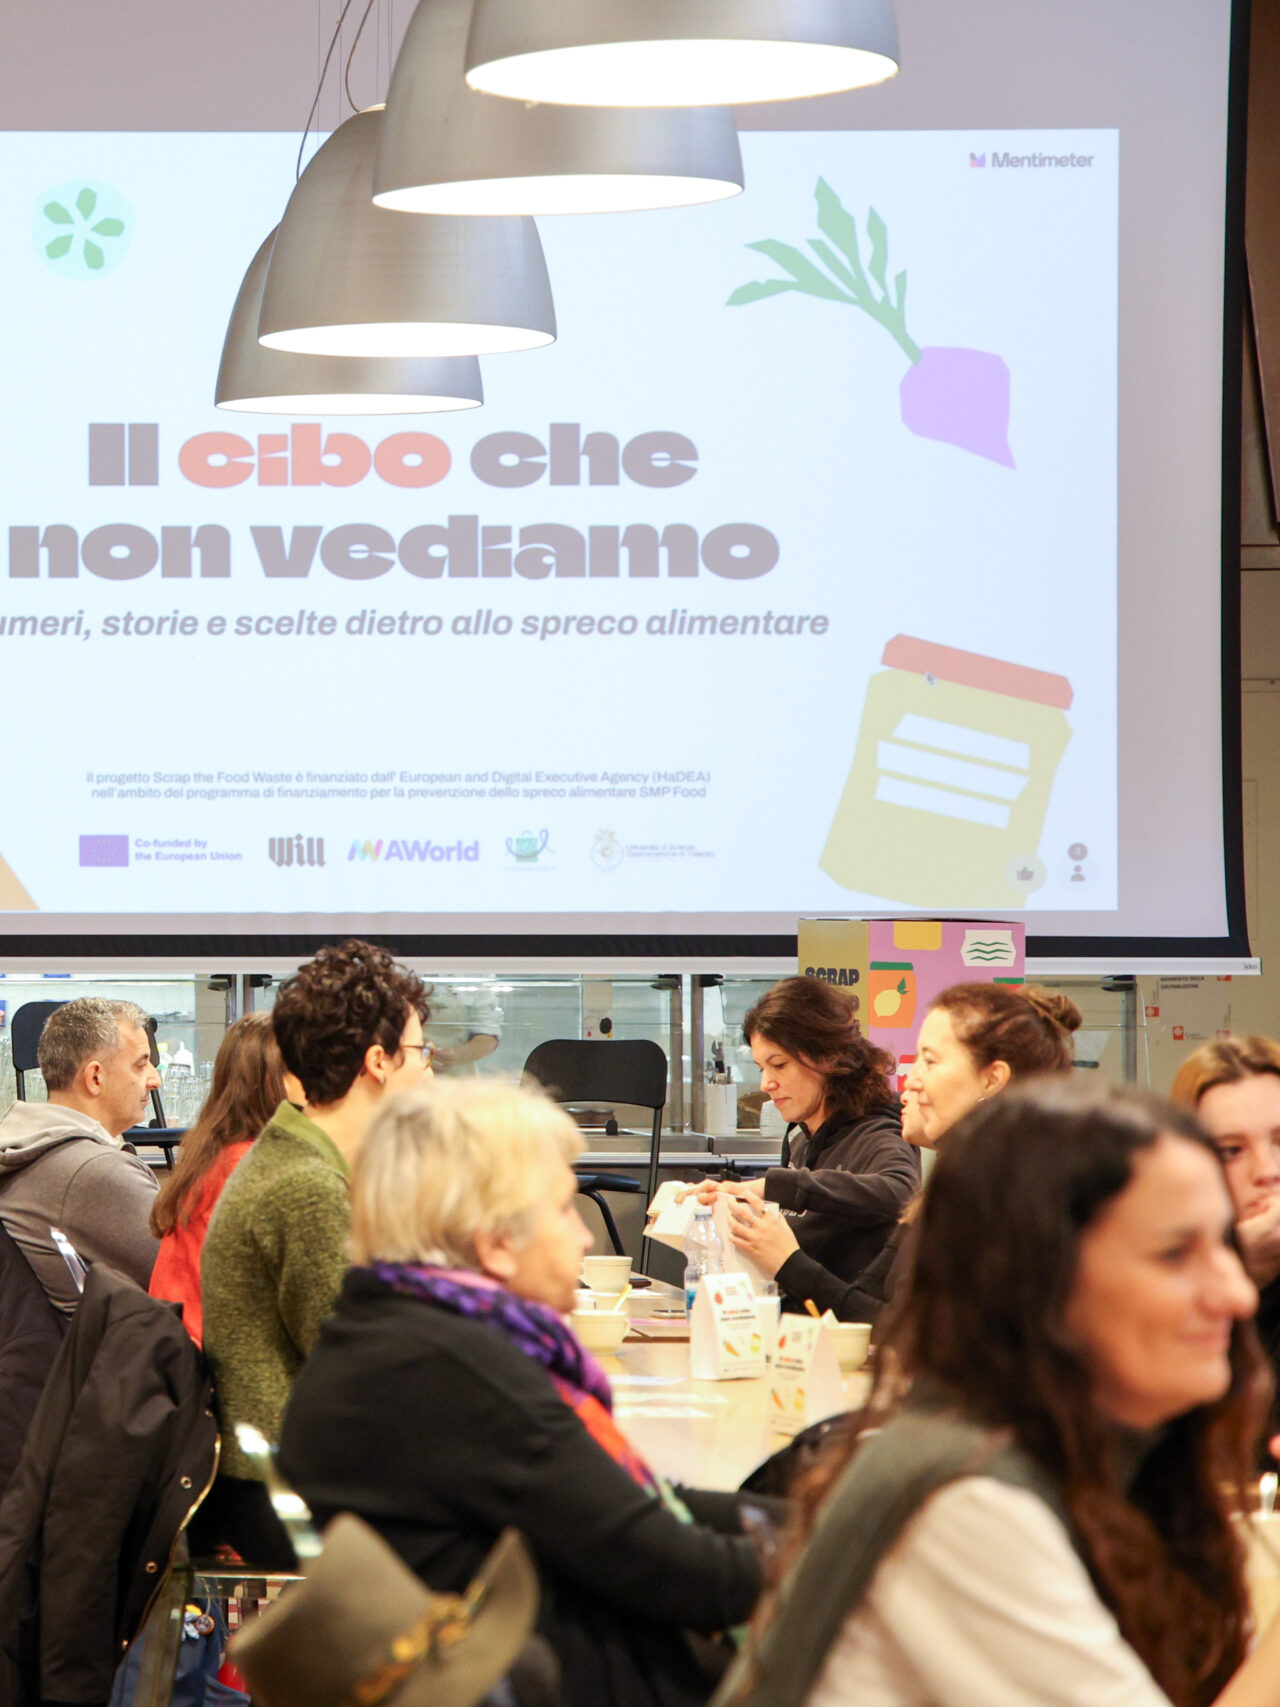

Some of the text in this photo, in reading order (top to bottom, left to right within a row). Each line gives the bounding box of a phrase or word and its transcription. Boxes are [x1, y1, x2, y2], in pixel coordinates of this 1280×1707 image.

[991, 151, 1095, 168] Mentimeter
[88, 422, 699, 489] Il cibo che
[8, 514, 781, 581] non vediamo
[101, 609, 199, 637] storie
[206, 615, 227, 636] e
[233, 609, 338, 636] scelte
[344, 608, 444, 636] dietro
[450, 608, 514, 636] allo
[520, 614, 639, 641] spreco
[645, 608, 830, 636] alimentare
[96, 772, 150, 785] progetto
[153, 772, 191, 785] Scrap
[194, 772, 214, 783] the
[217, 772, 250, 783] Food
[252, 772, 293, 783] Waste
[306, 771, 368, 783] finanziato
[399, 772, 462, 785] European
[464, 771, 489, 783] and
[492, 771, 532, 785] Digital
[535, 771, 598, 783] Executive
[600, 771, 649, 785] Agency
[652, 771, 711, 785] (HaDEA)
[91, 786, 707, 800] nell'ambito del programma di finanziamento per la prevenzione dello spreco alimentare SMP Food
[134, 838, 208, 850] Co-funded by
[384, 839, 480, 863] AWorld
[134, 851, 243, 863] the European Union
